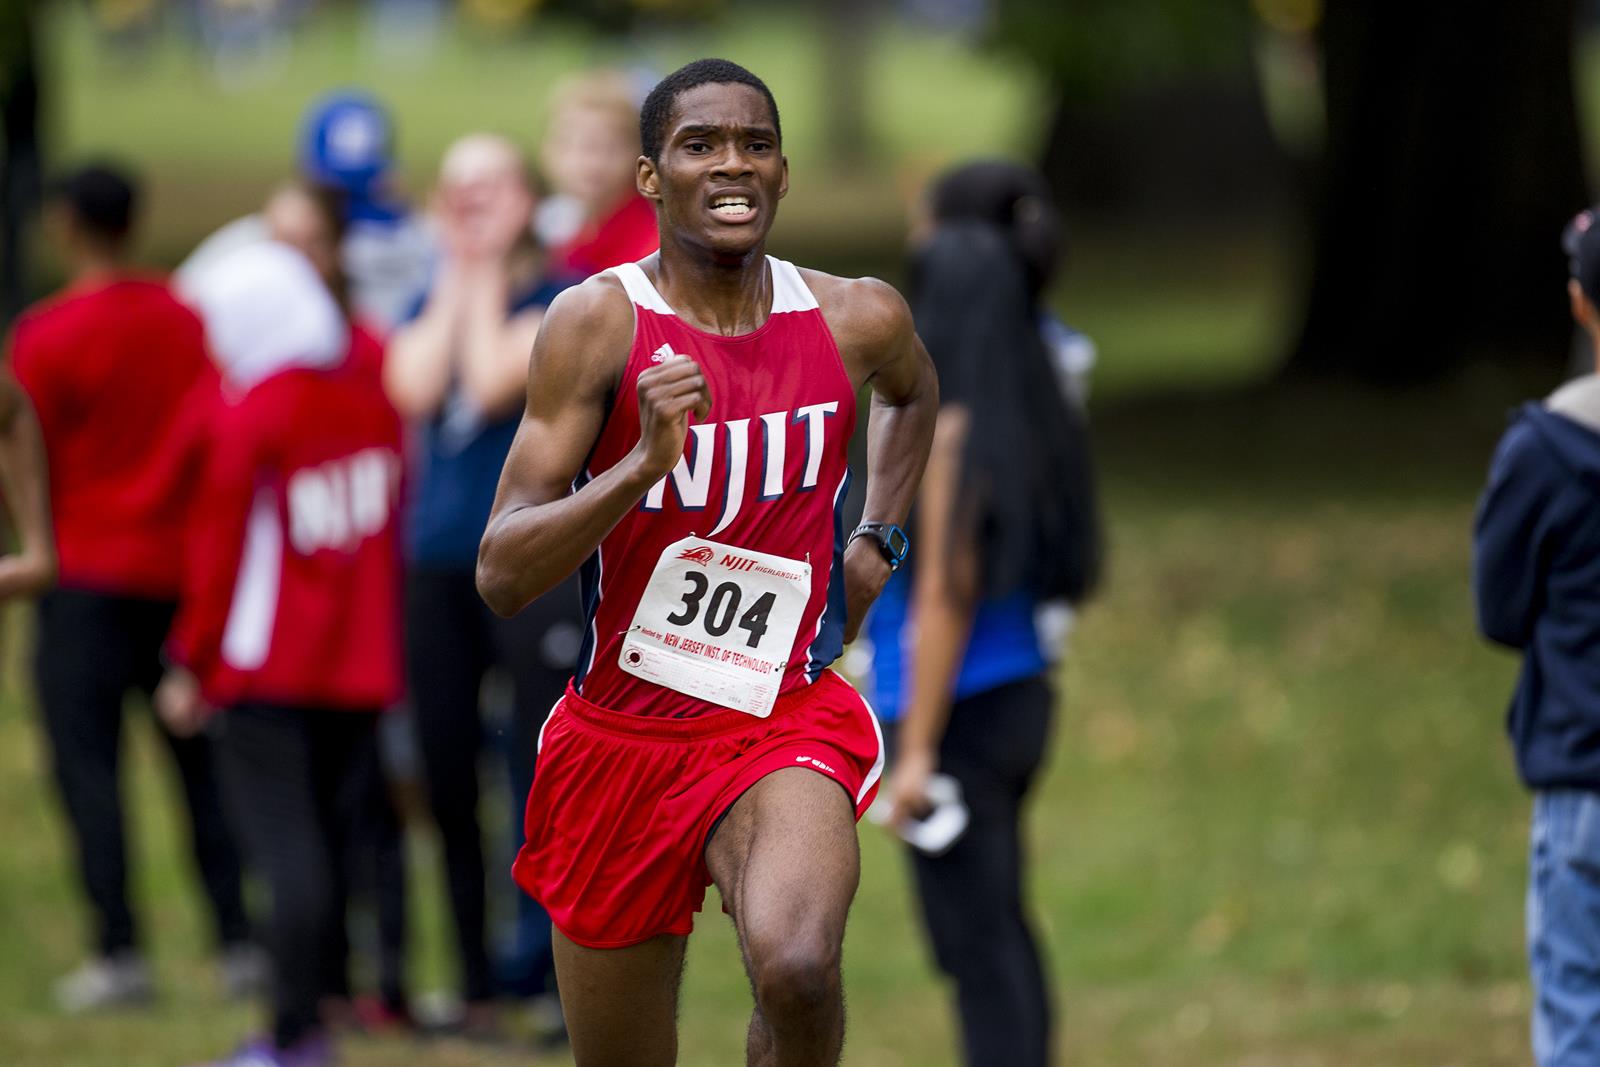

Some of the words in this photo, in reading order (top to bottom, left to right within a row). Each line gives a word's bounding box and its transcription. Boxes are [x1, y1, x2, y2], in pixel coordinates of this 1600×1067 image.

[287, 446, 402, 556] NJI
[640, 401, 839, 538] NJIT
[719, 554, 758, 572] NJIT
[666, 571, 777, 649] 304
[663, 633, 680, 648] NEW
[679, 638, 706, 655] JERSEY
[703, 645, 720, 660] INST.
[721, 649, 732, 662] OF
[731, 652, 774, 674] TECHNOLOGY
